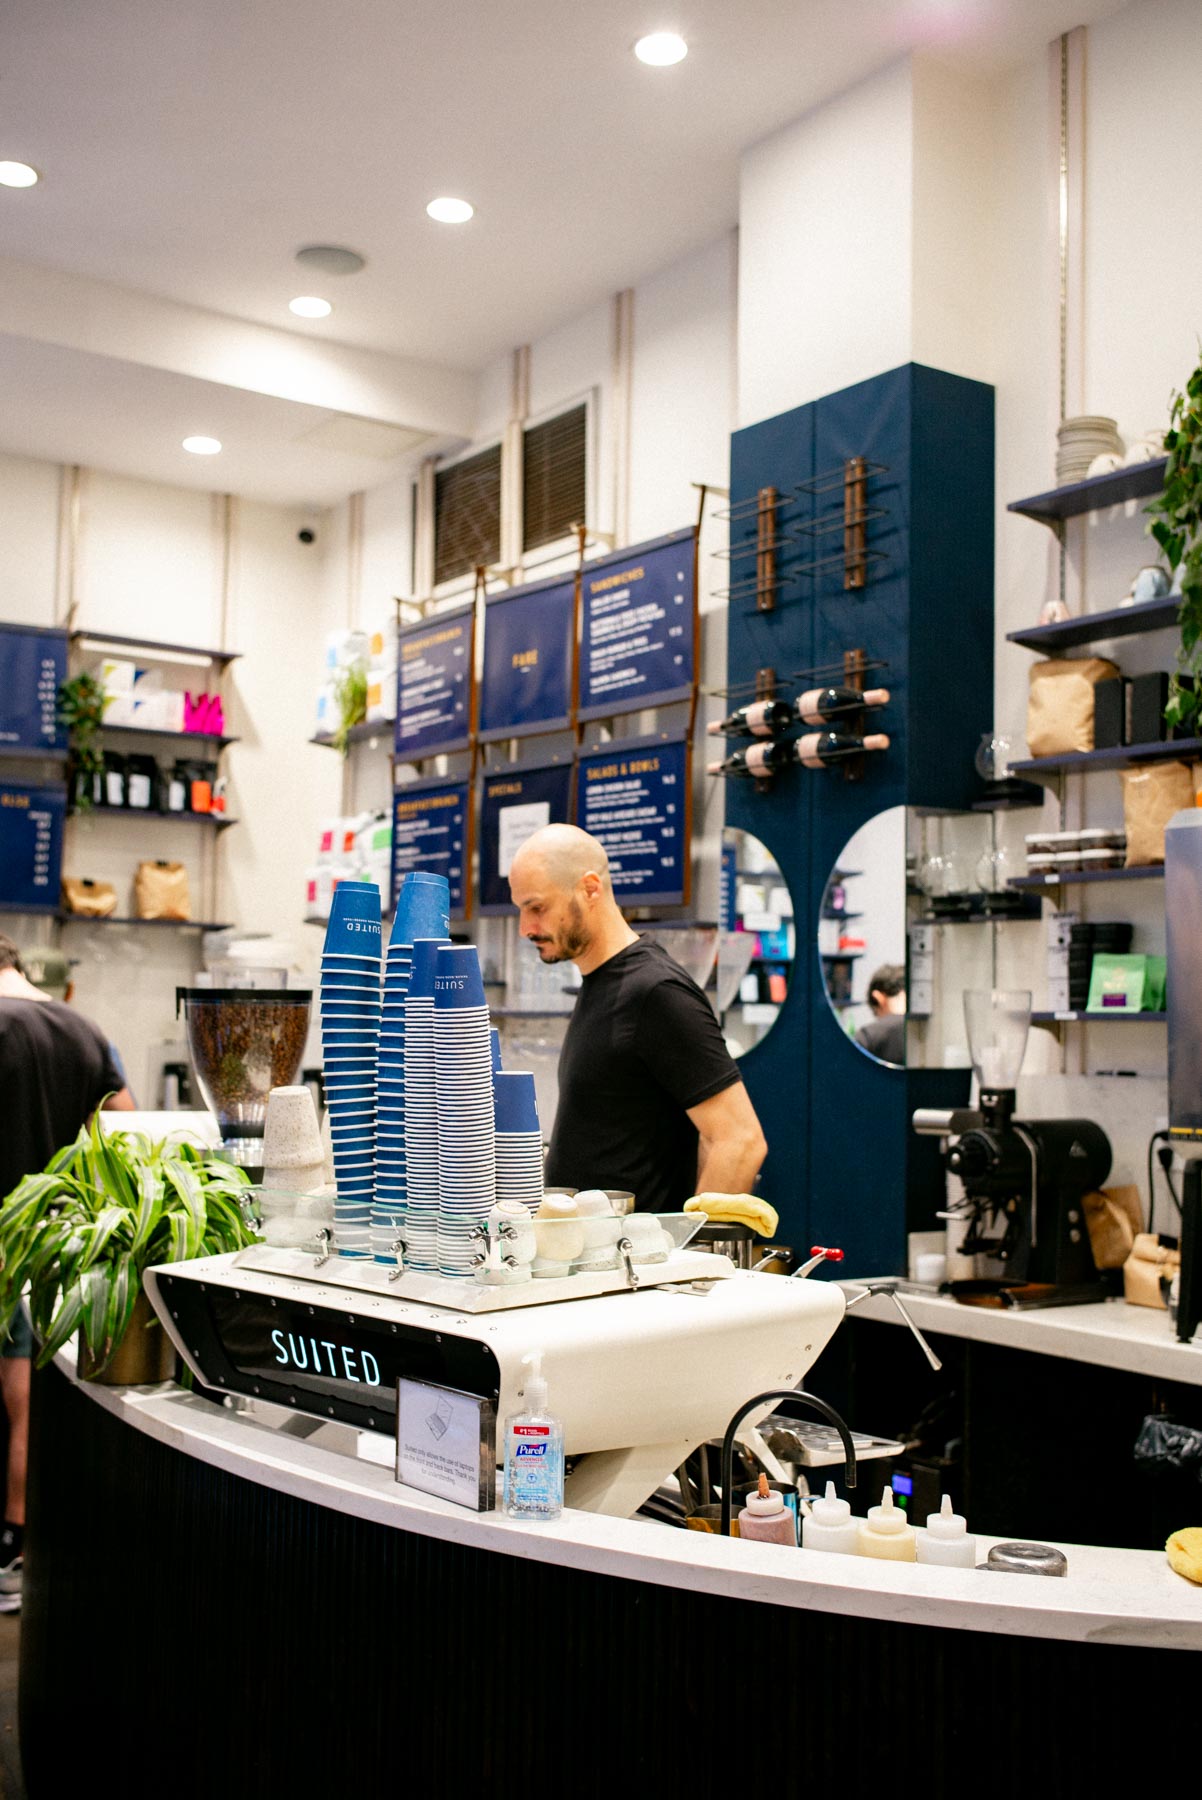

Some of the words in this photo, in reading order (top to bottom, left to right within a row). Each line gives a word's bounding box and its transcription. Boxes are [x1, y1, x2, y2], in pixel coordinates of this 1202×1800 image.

[347, 923, 381, 934] SUITED
[271, 1329, 380, 1386] SUITED
[519, 1445, 543, 1454] Purell
